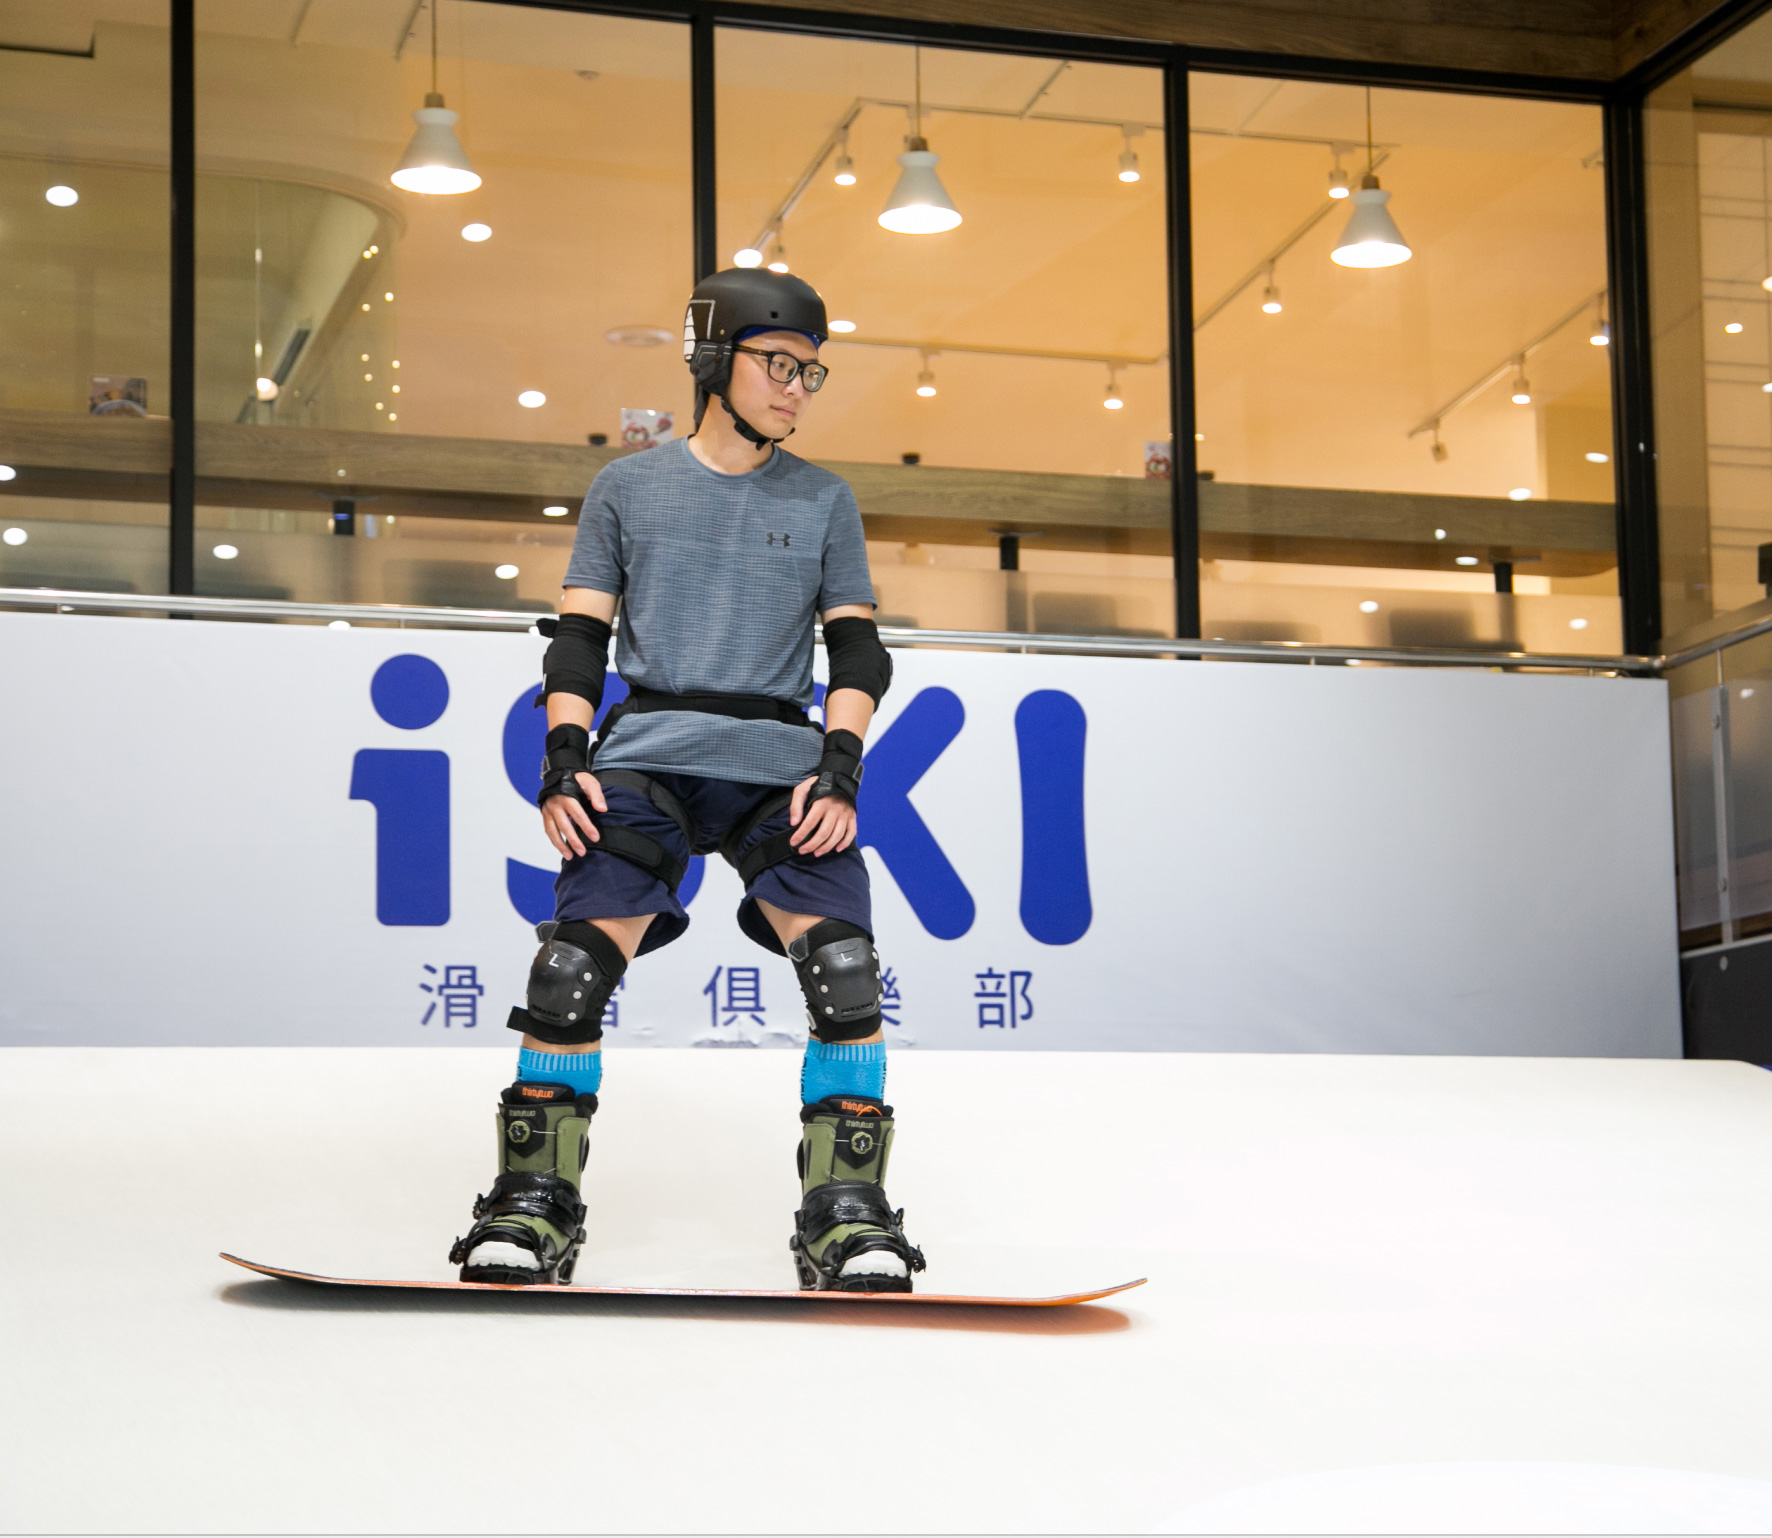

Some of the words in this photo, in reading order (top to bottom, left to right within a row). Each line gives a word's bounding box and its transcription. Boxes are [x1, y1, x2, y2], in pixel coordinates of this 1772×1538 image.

[841, 953, 853, 962] L
[418, 963, 1035, 1029] 滑俱部
